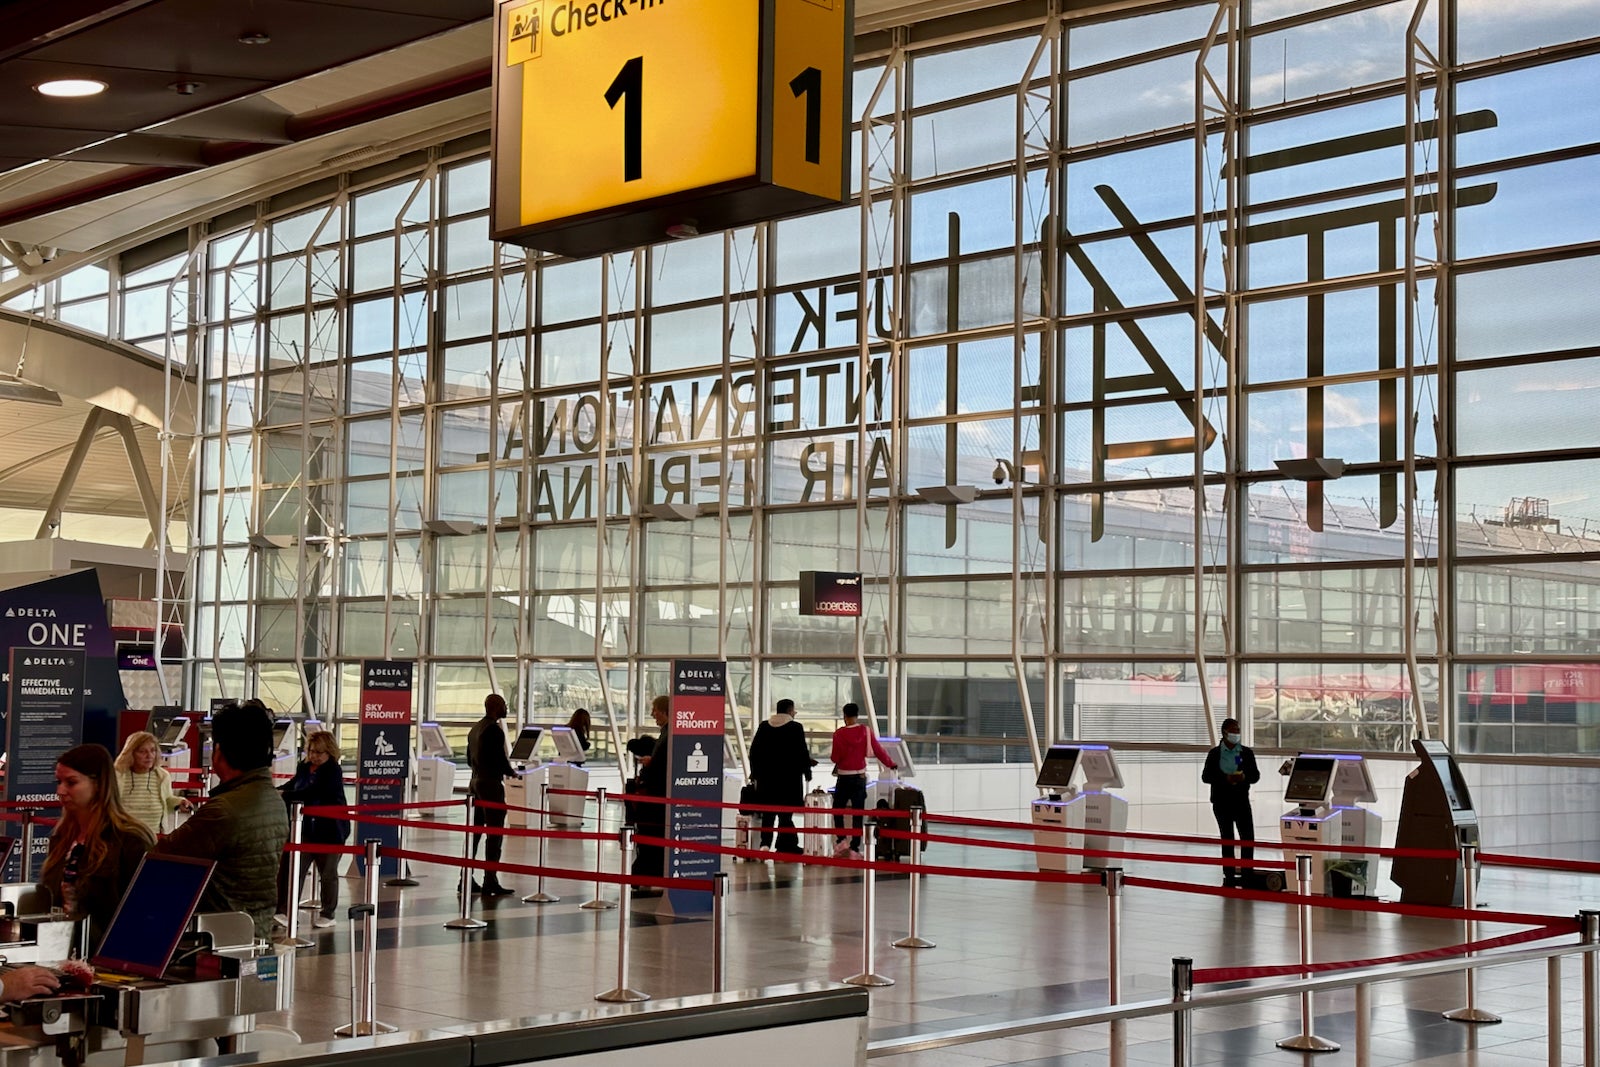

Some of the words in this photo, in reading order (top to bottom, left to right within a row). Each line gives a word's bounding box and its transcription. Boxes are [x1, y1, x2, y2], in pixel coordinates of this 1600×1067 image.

[604, 56, 643, 183] 1
[789, 66, 822, 165] 1
[18, 608, 57, 618] DELTA
[28, 622, 86, 646] ONE
[33, 657, 66, 666] DELTA
[376, 668, 402, 676] DELTA
[687, 670, 714, 678] DELTA
[21, 679, 61, 687] EFFECTIVE
[21, 687, 75, 696] IMMEDIATELY
[365, 703, 383, 711] SKY
[365, 711, 405, 719] PRIORITY
[676, 711, 695, 719] SKY
[676, 720, 718, 728] PRIORITY
[368, 767, 382, 775] BAG
[383, 767, 401, 775] DROP
[674, 778, 696, 786] AGENT
[696, 777, 719, 785] ASSIST
